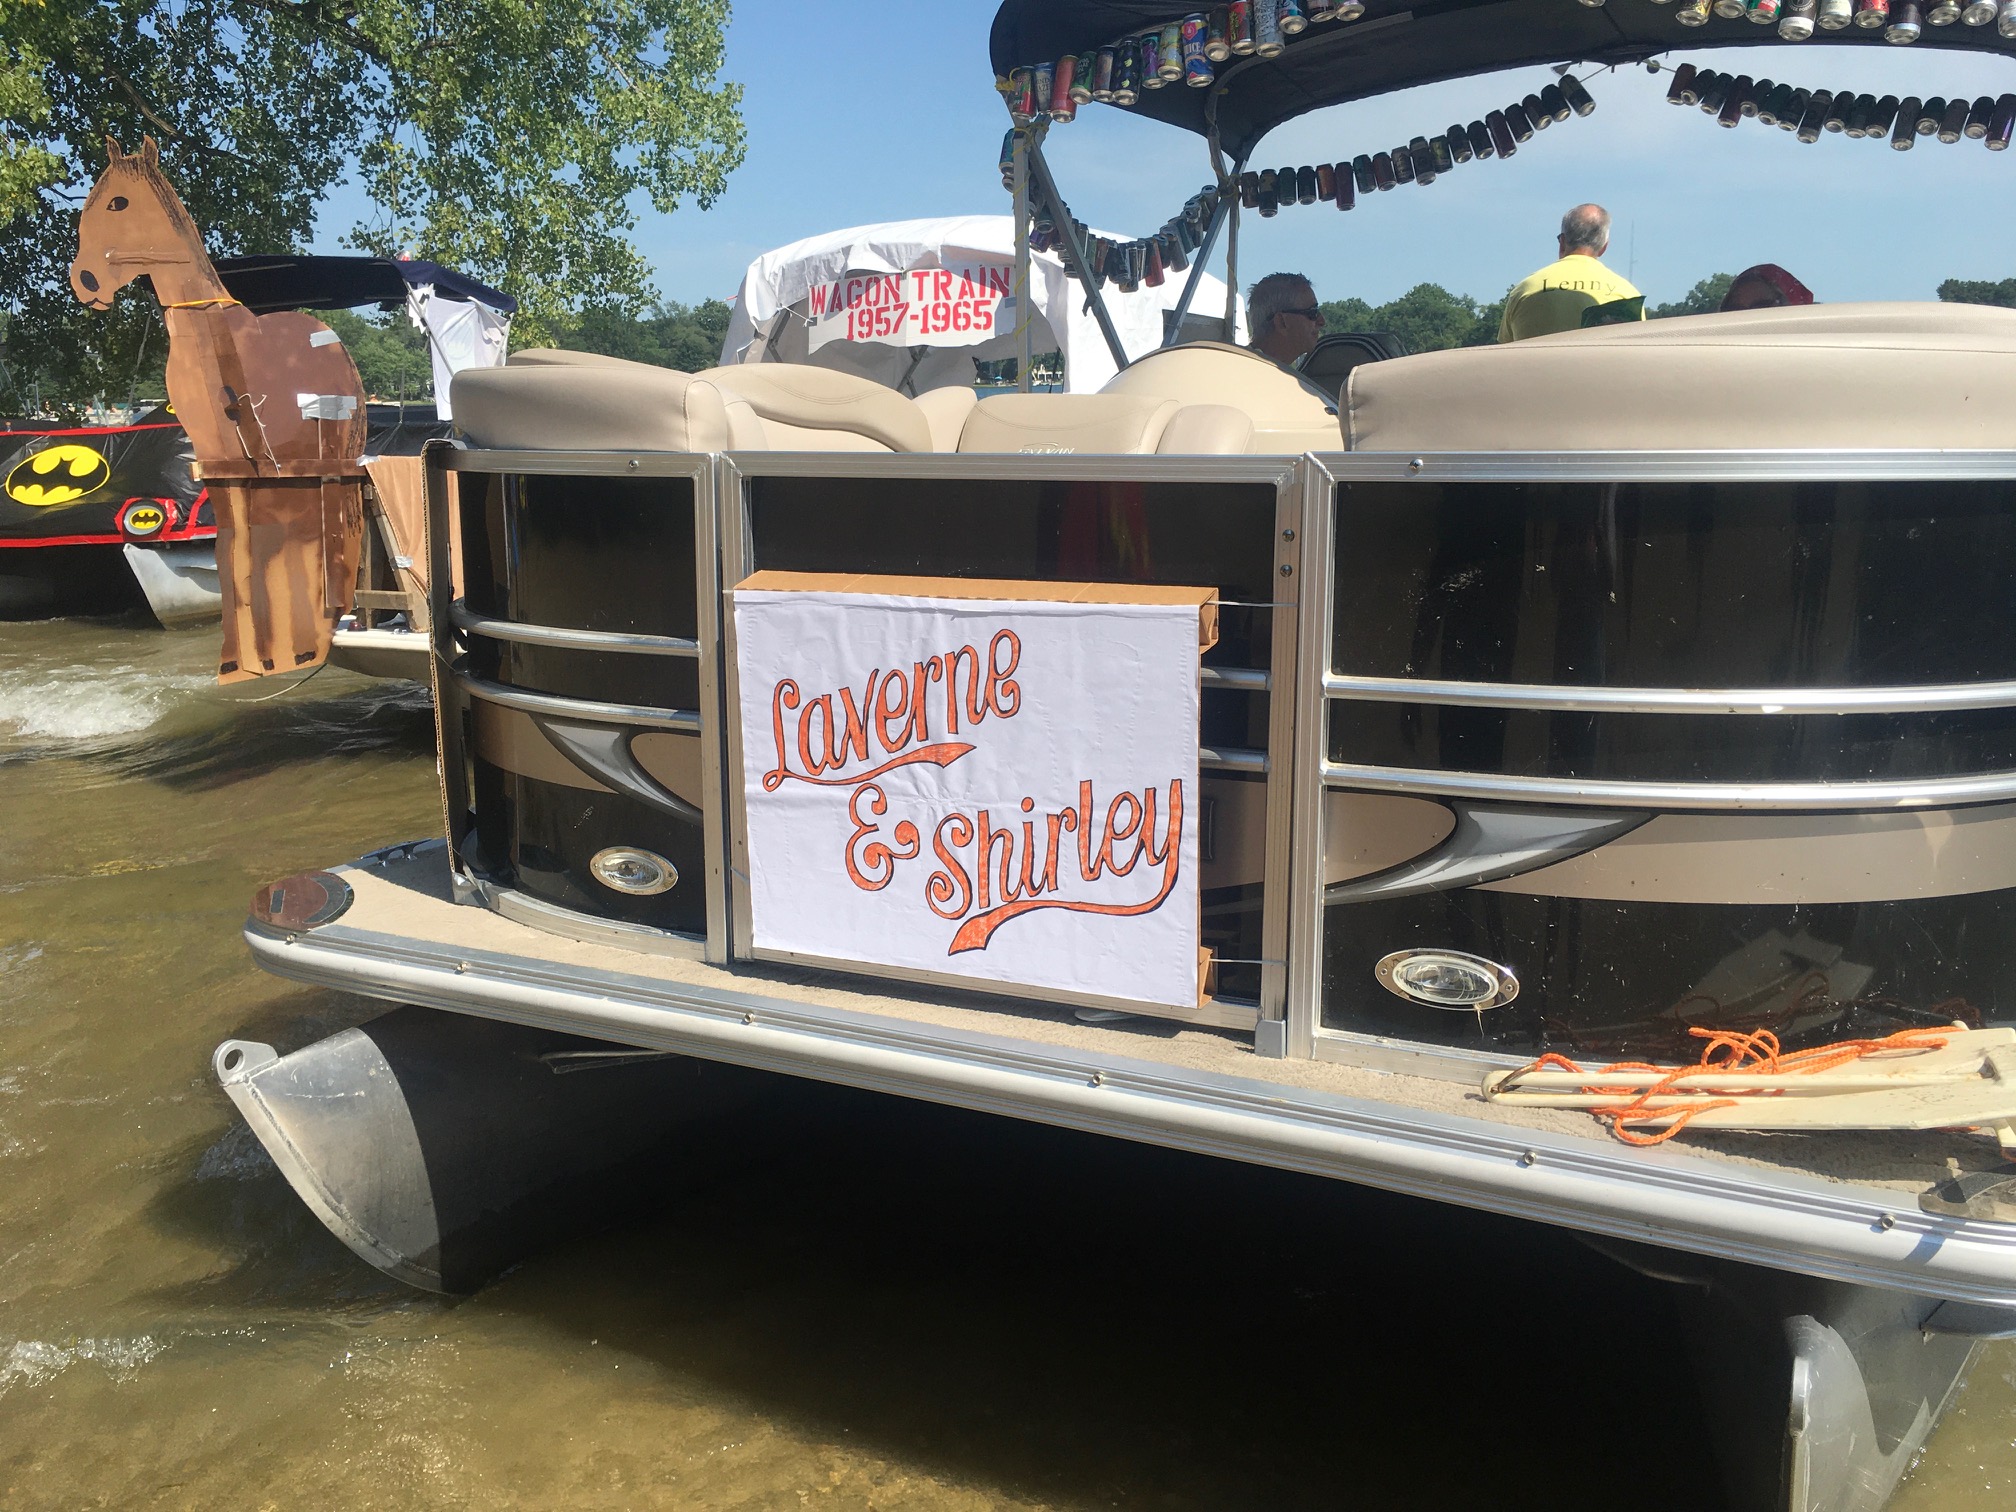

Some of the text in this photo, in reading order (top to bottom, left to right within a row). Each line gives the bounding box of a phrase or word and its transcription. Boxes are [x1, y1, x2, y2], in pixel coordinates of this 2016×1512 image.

[810, 265, 1011, 316] WAGON TRAIN
[1542, 278, 1617, 296] Lenny
[846, 299, 993, 341] 1957-1965
[762, 629, 1022, 793] Laverne
[844, 778, 1183, 956] & Shirley
